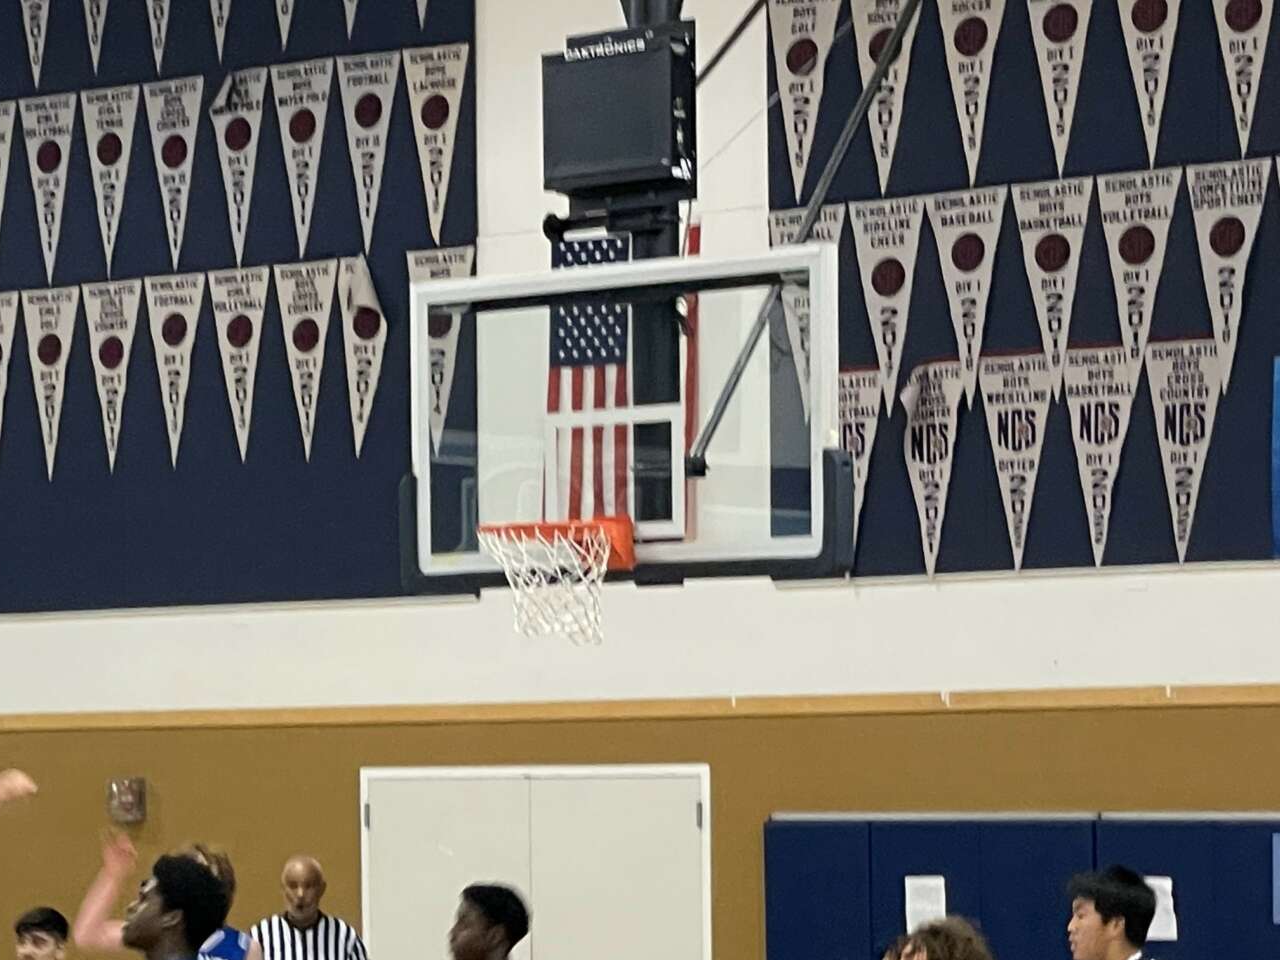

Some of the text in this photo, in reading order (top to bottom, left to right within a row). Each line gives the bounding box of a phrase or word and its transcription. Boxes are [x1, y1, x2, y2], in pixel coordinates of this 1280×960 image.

[1070, 349, 1127, 365] SCHOLASTI
[911, 423, 949, 464] NCS
[997, 409, 1036, 451] NCS
[1080, 402, 1120, 445] NCS
[1164, 403, 1206, 446] NCS
